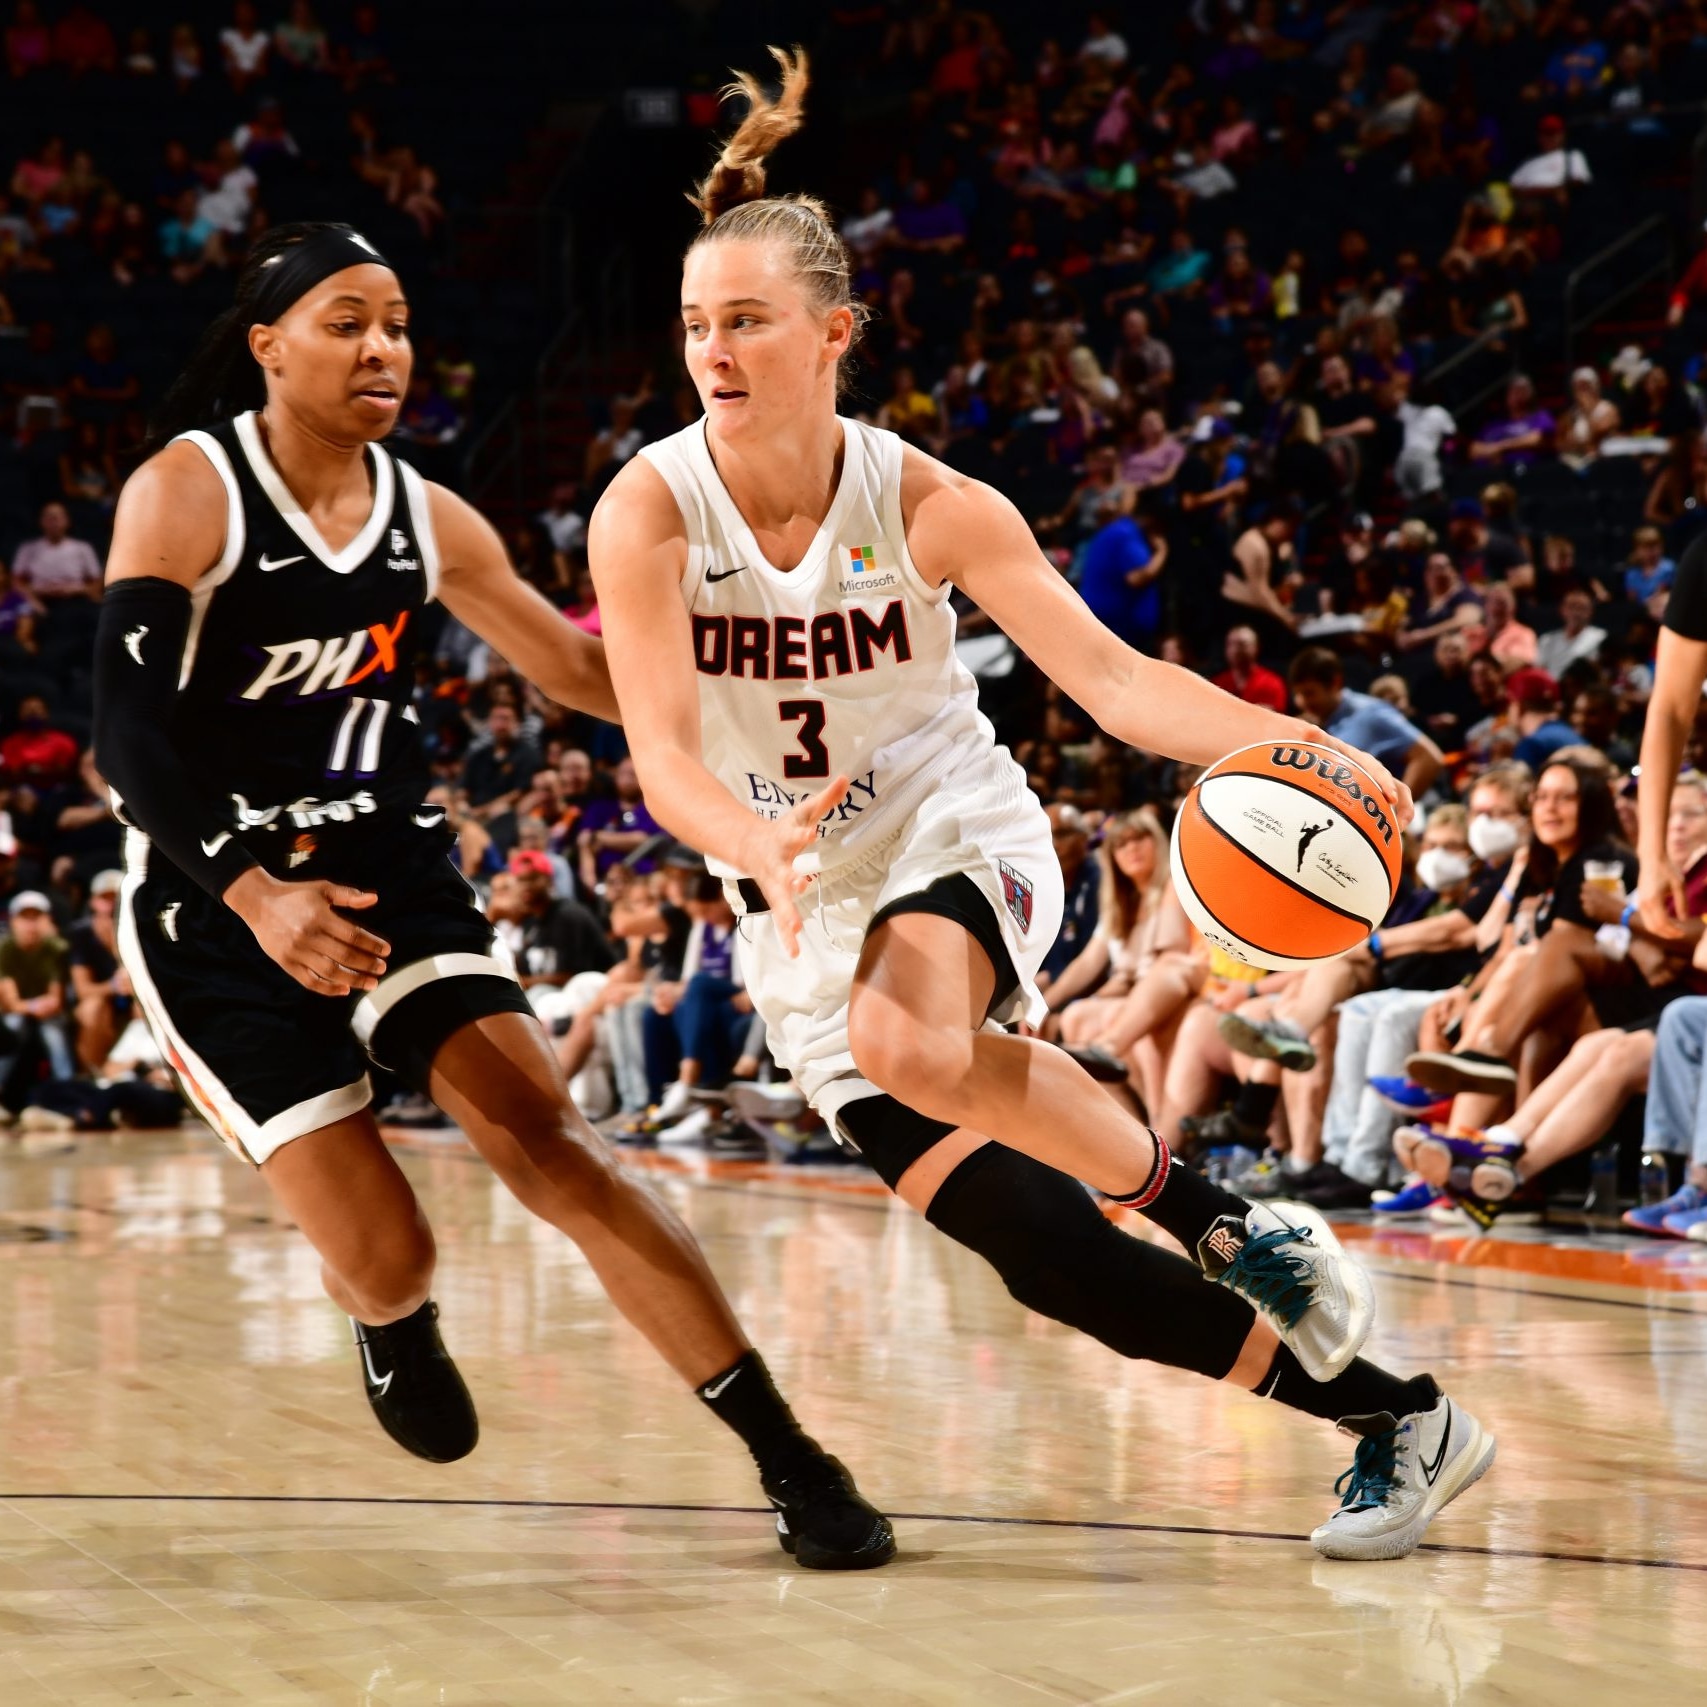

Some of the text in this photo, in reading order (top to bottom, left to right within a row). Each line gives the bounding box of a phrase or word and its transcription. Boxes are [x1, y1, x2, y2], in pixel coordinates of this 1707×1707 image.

[839, 573, 896, 593] Microsoft
[240, 610, 410, 700] PHX
[692, 600, 913, 681] DREAM
[325, 696, 391, 779] 11
[778, 699, 830, 779] 3
[745, 770, 877, 822] EMRY
[1251, 807, 1284, 829] OFFICIAL
[1243, 811, 1265, 826] GAME
[1265, 822, 1285, 839] BALL
[1000, 861, 1033, 894] ATLANTA
